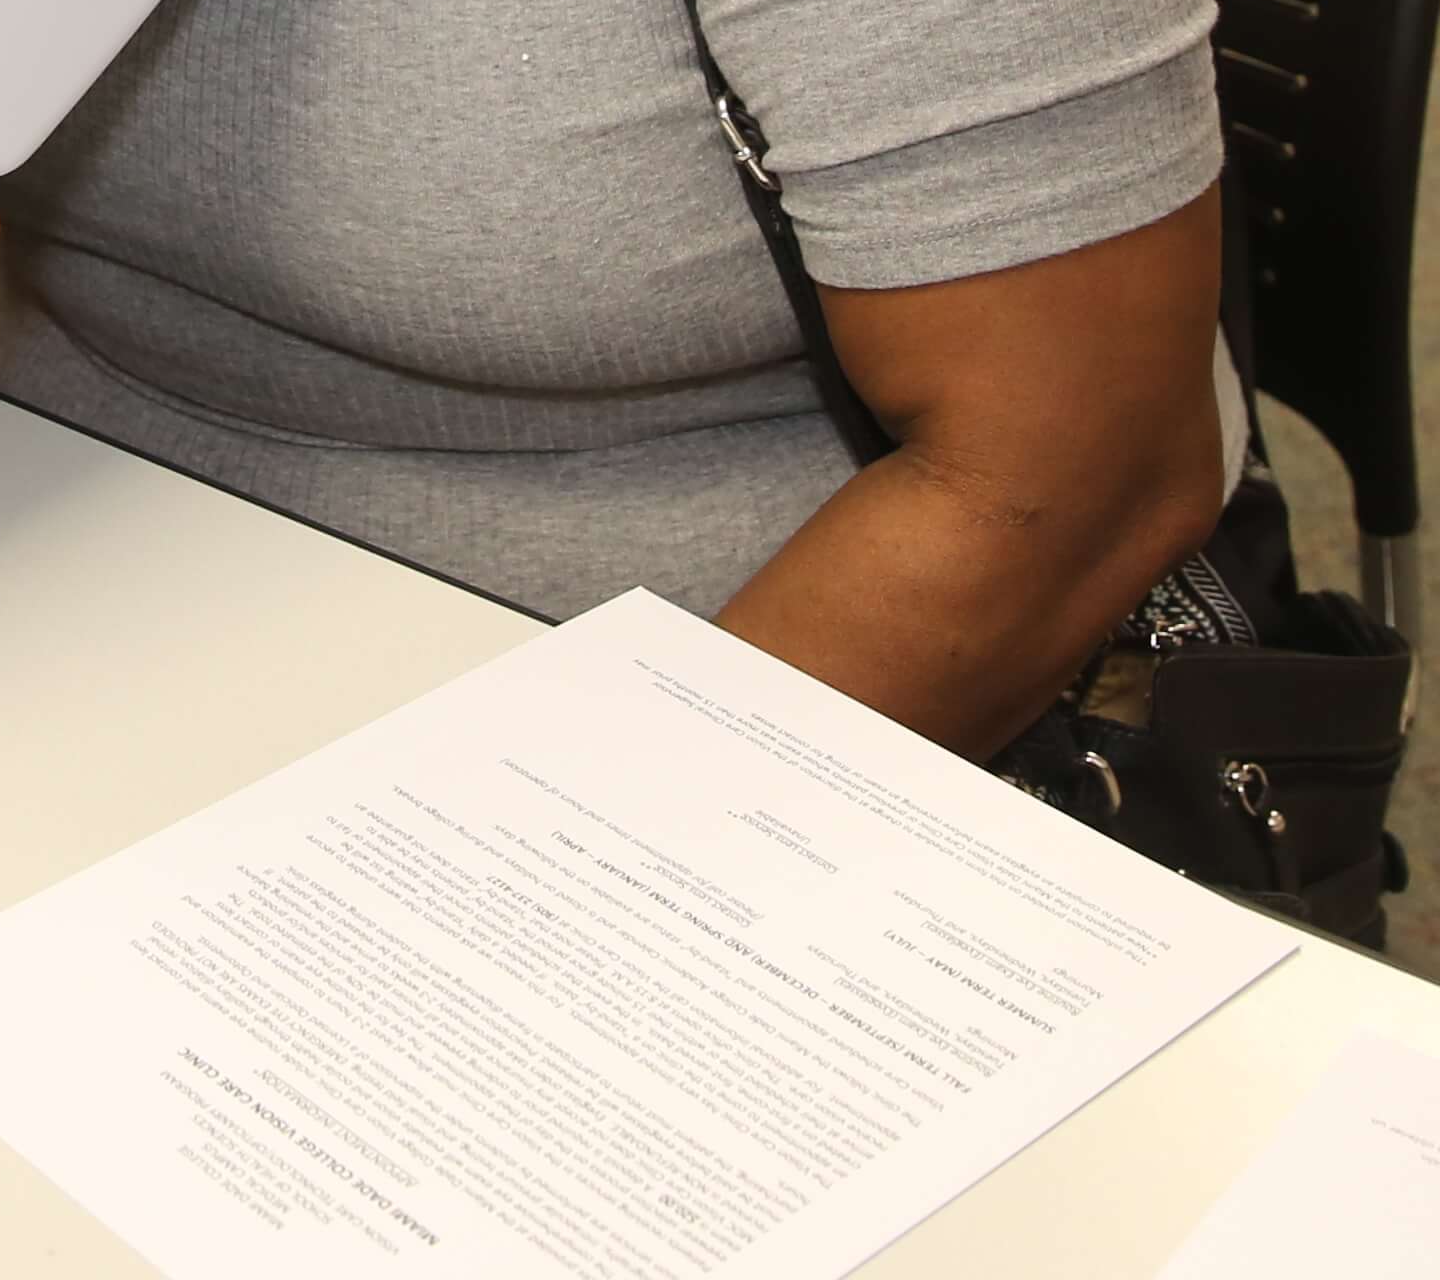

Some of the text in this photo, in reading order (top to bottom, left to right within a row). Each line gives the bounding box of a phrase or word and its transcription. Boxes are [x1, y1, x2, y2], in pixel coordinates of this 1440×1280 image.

[551, 830, 972, 1094] FALL TERM (SEPTEMBER DECEMBER) AND SPRING TERM (JANUARY APRIL)
[883, 929, 1056, 1034] SUMMER TERM (MAY JULY)
[178, 1047, 437, 1246] MIAMI DADE COLLEGE VISION CARE CLINIC
